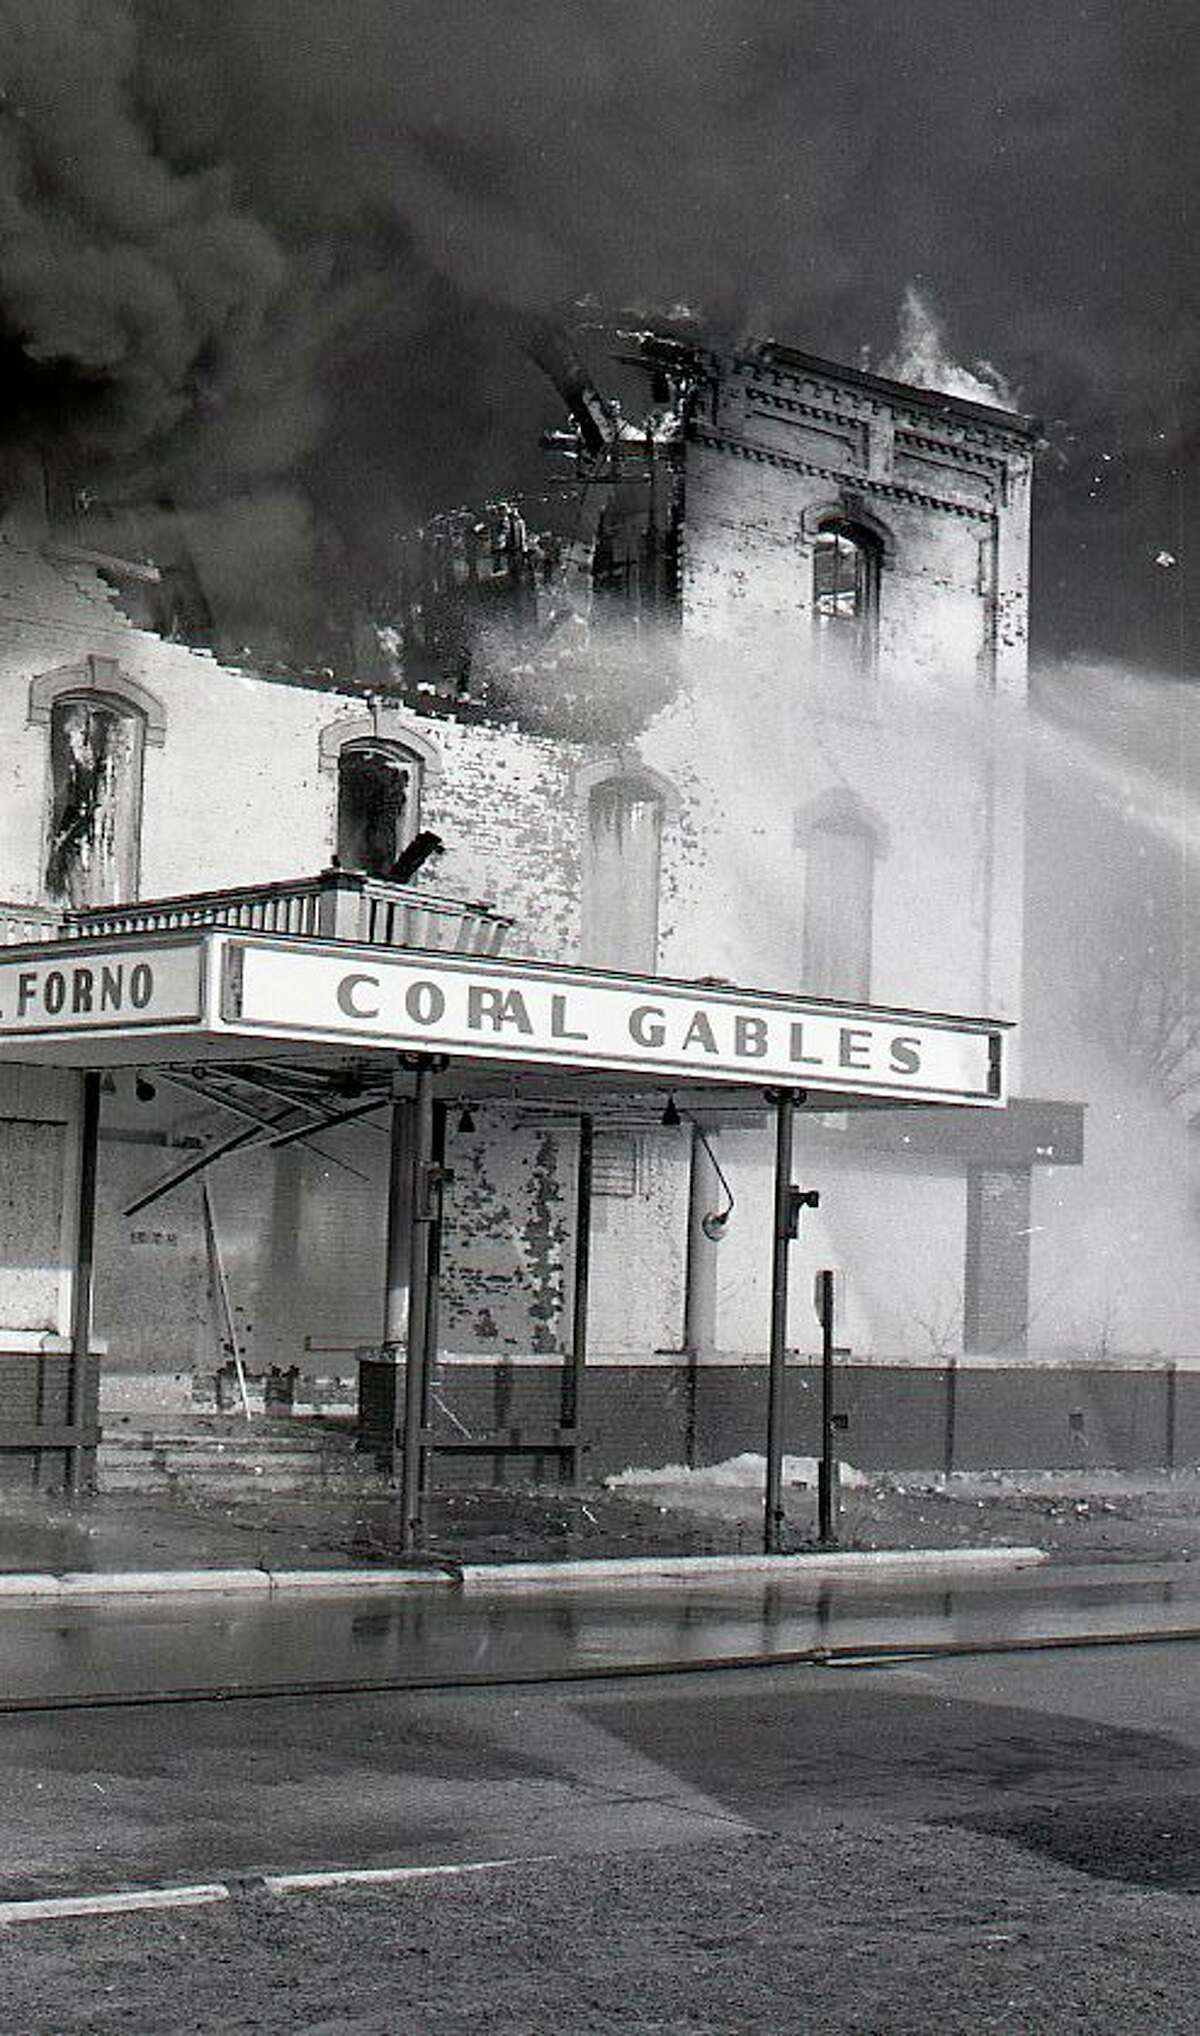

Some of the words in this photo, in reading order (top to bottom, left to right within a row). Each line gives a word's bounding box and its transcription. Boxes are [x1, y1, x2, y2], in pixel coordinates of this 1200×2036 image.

[17, 963, 154, 1017] FORNO
[337, 974, 588, 1040] CORAL
[628, 1005, 922, 1075] GABLES
